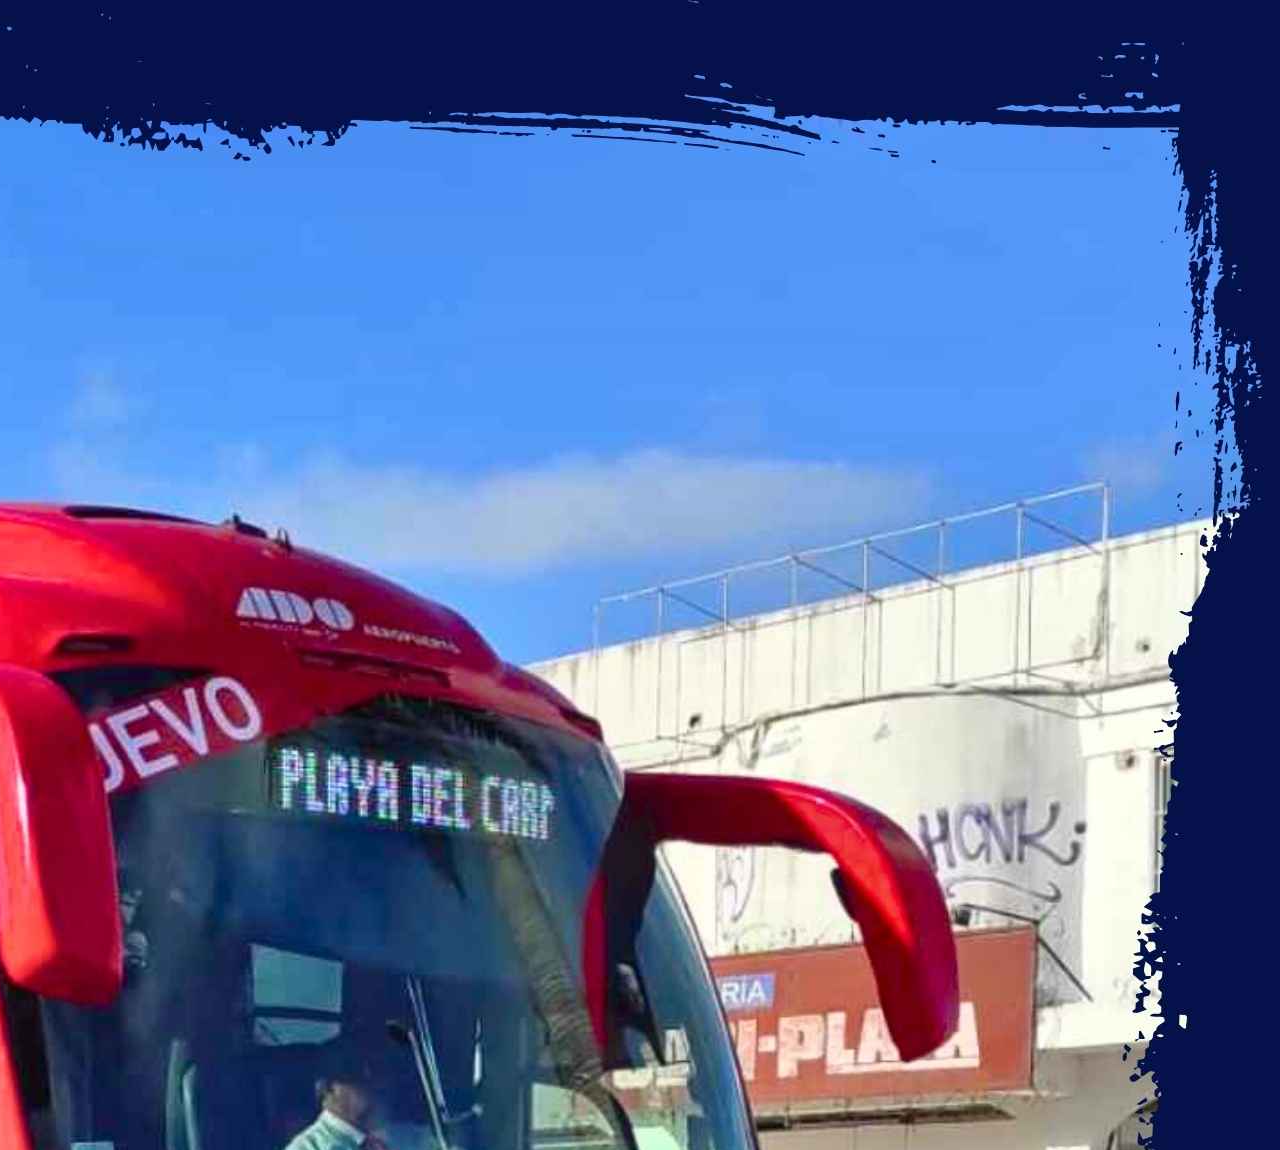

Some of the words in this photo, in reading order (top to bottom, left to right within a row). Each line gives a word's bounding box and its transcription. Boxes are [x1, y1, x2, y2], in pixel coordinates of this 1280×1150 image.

[236, 587, 355, 631] ADO
[280, 748, 398, 820] PLAYA
[411, 765, 471, 829] DEL
